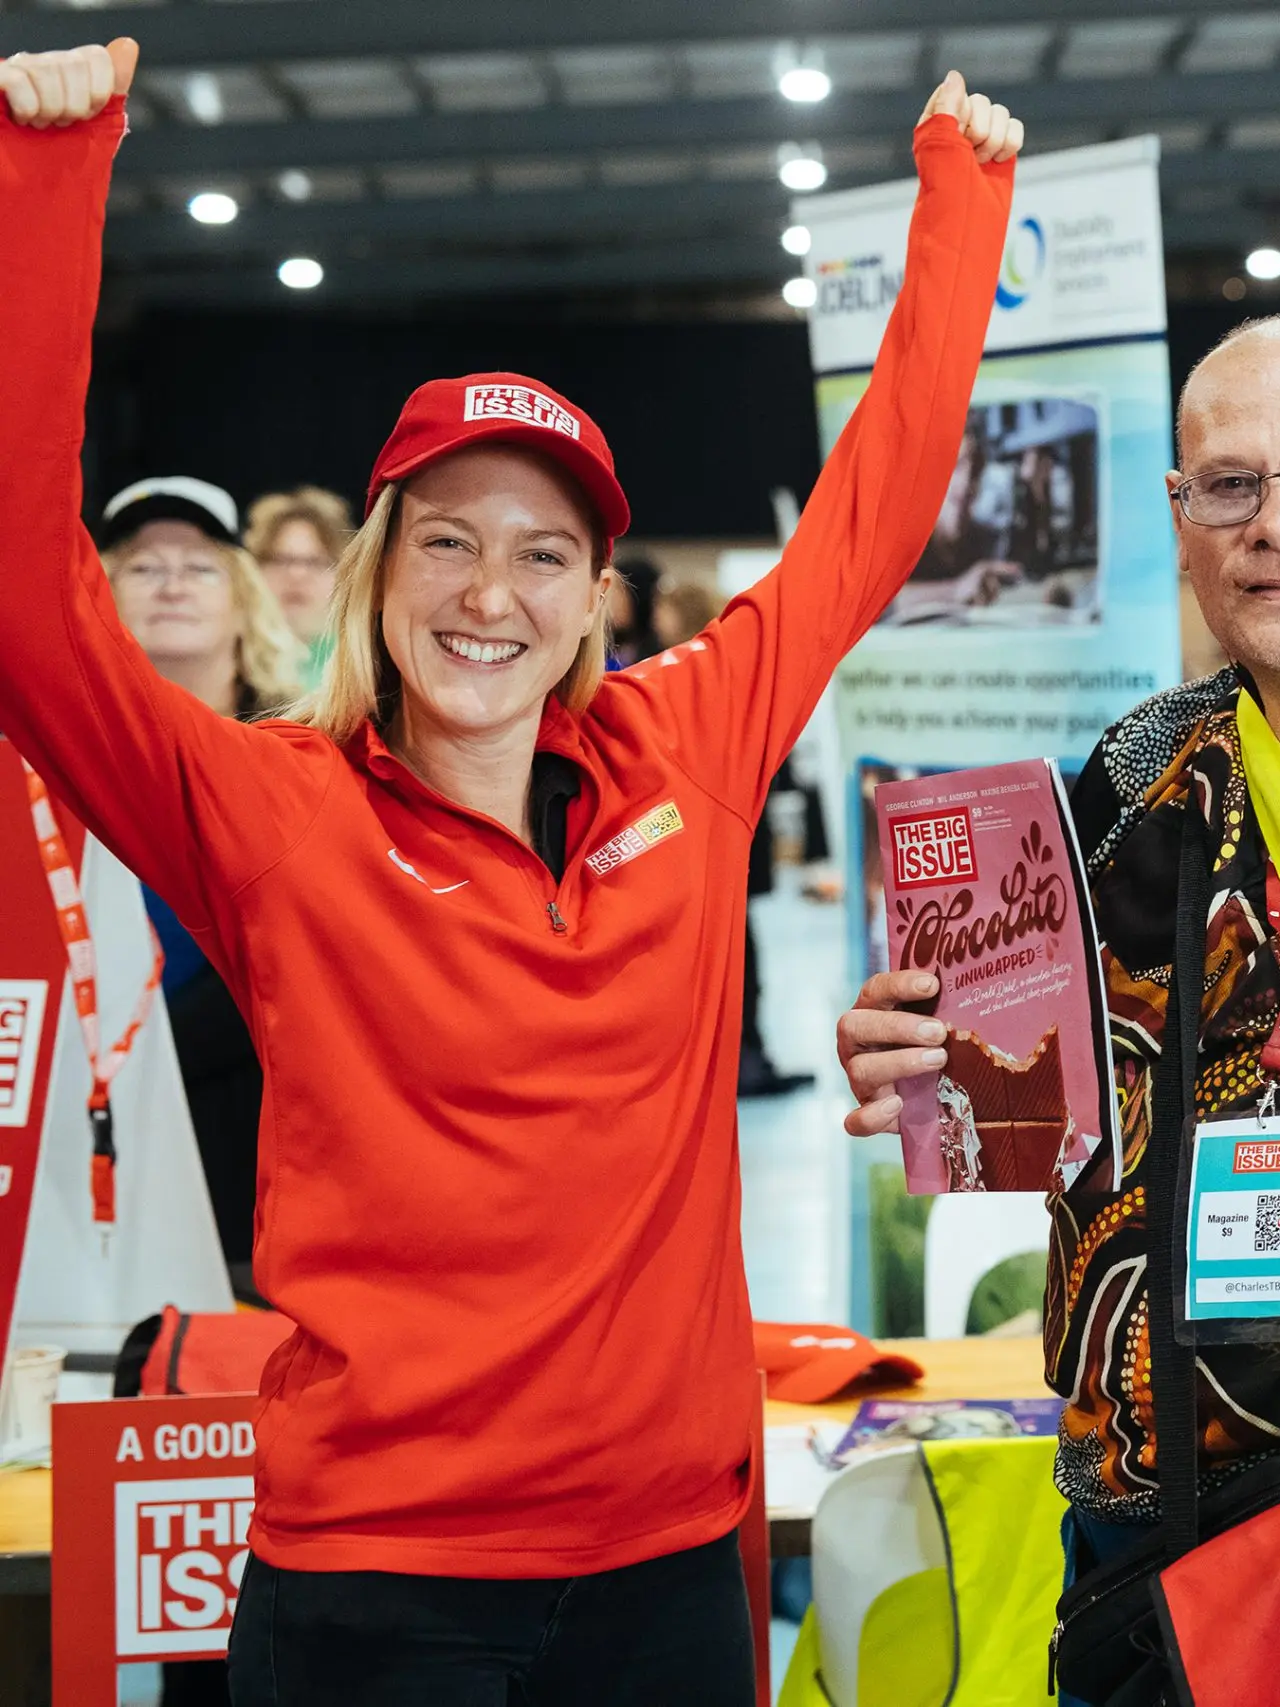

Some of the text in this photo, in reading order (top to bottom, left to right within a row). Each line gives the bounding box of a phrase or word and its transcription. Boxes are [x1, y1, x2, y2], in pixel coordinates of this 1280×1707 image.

[475, 388, 573, 428] THE BIG
[475, 398, 573, 437] ISSUE
[909, 797, 934, 810] CLINTON
[949, 790, 977, 802] ANDERSON
[587, 829, 635, 864] THE BIG
[896, 820, 931, 845] THE
[937, 817, 966, 840] BIG
[592, 836, 644, 873] ISSUE
[899, 839, 971, 880] ISSUE
[899, 861, 1068, 971] Chocolate
[955, 947, 1036, 990] UNWRAPPED
[971, 986, 996, 1003] Roald
[1239, 1144, 1264, 1155] THE
[1207, 1213, 1249, 1225] Magazine
[1221, 1227, 1233, 1237] $9
[116, 1421, 256, 1463] A GOOD
